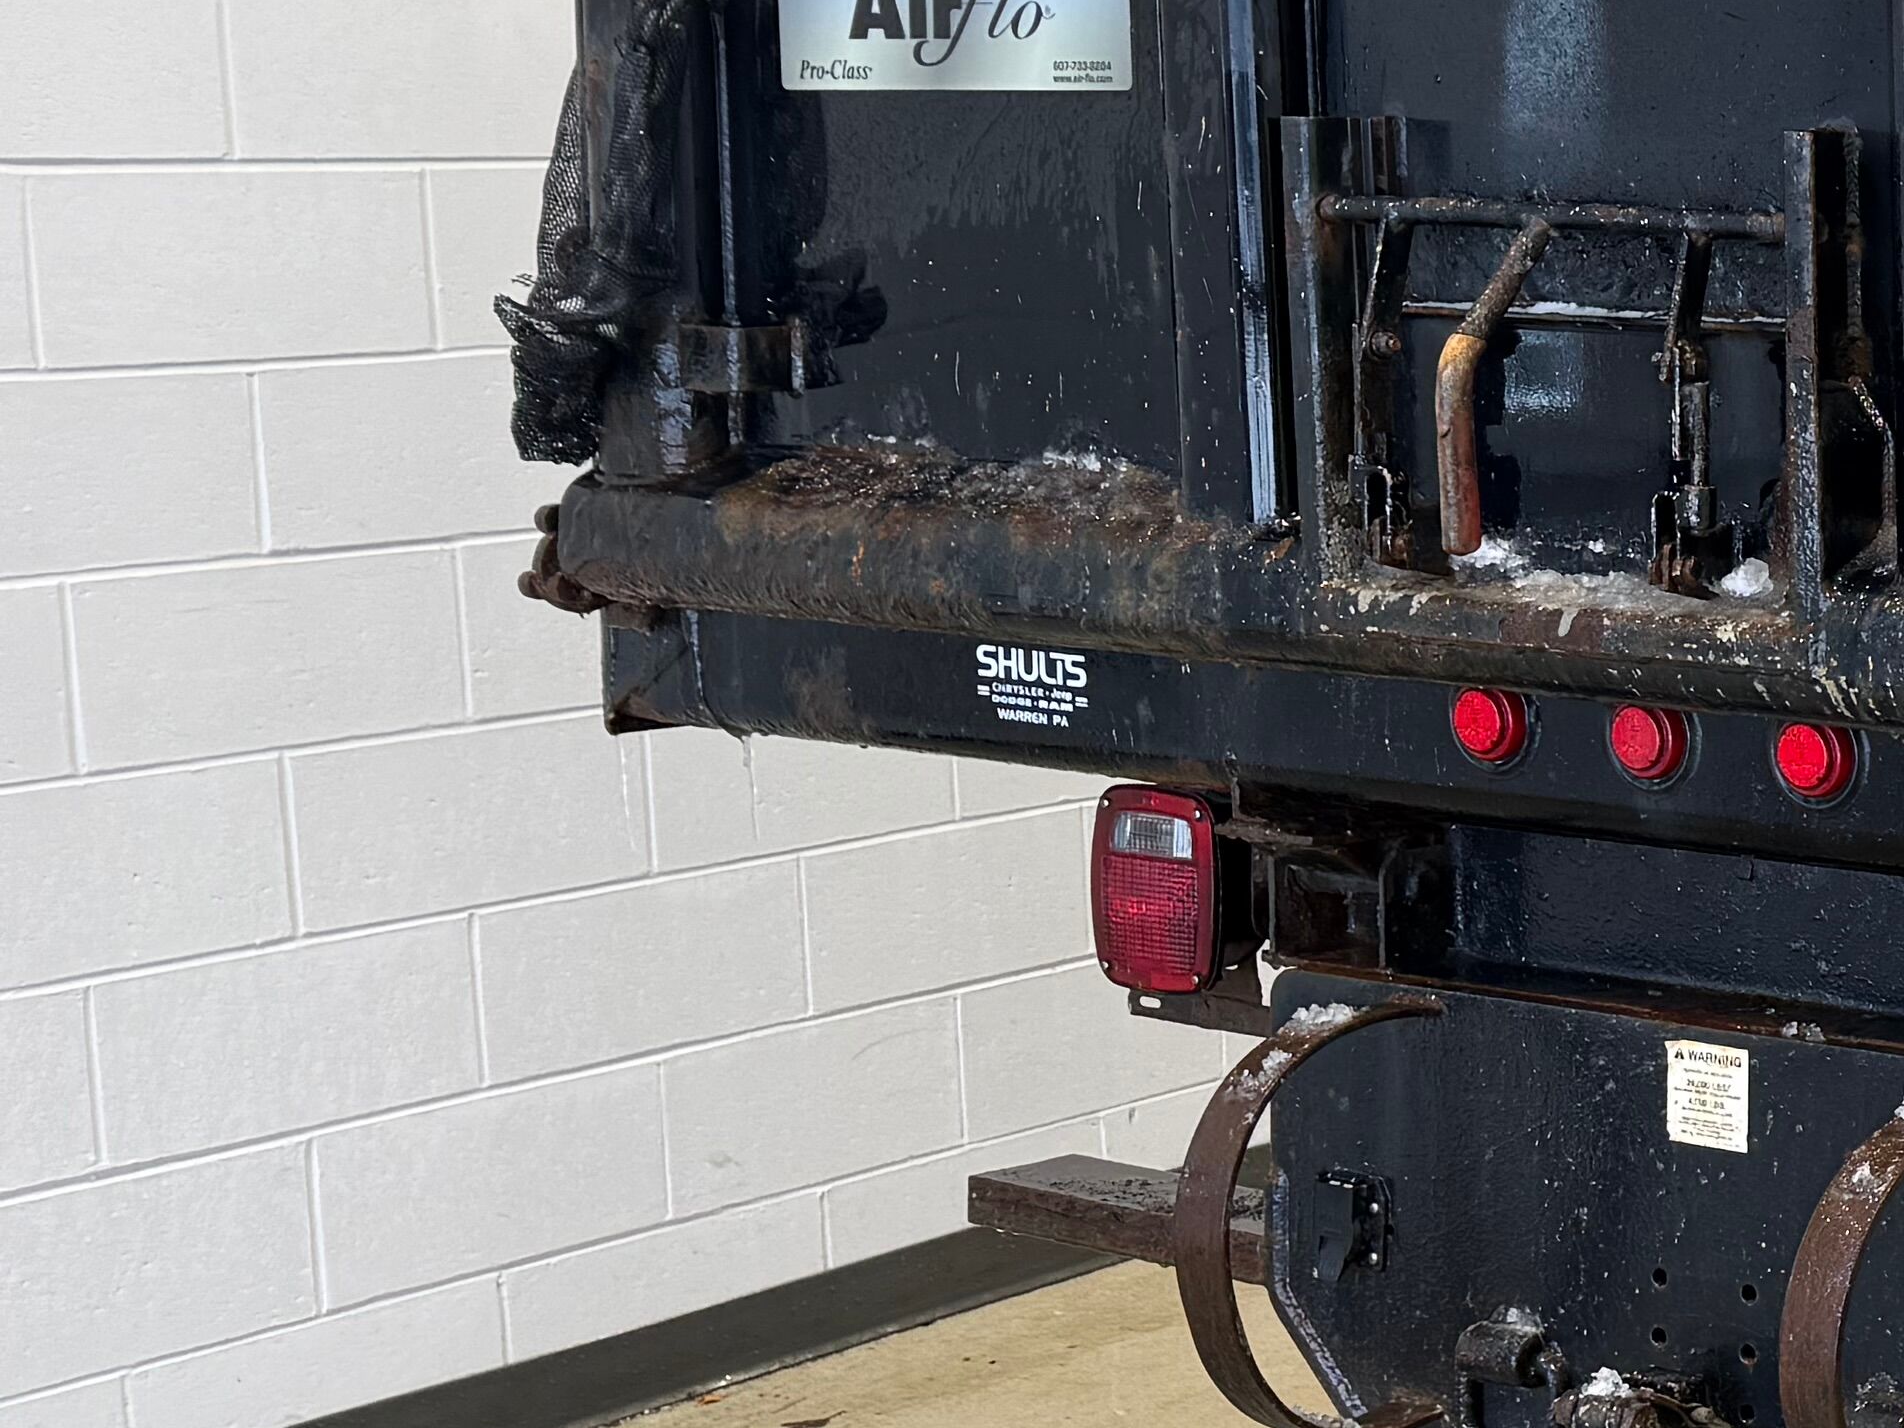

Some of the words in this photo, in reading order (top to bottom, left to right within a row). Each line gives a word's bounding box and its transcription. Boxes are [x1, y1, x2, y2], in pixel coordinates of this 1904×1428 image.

[976, 644, 1088, 688] SHULTS
[991, 694, 1033, 708] DODGE
[1038, 699, 1074, 712] RAM
[1051, 688, 1073, 702] Jeep
[997, 707, 1048, 725] WARREN
[1052, 714, 1069, 728] PA
[1688, 1049, 1742, 1068] WARNING
